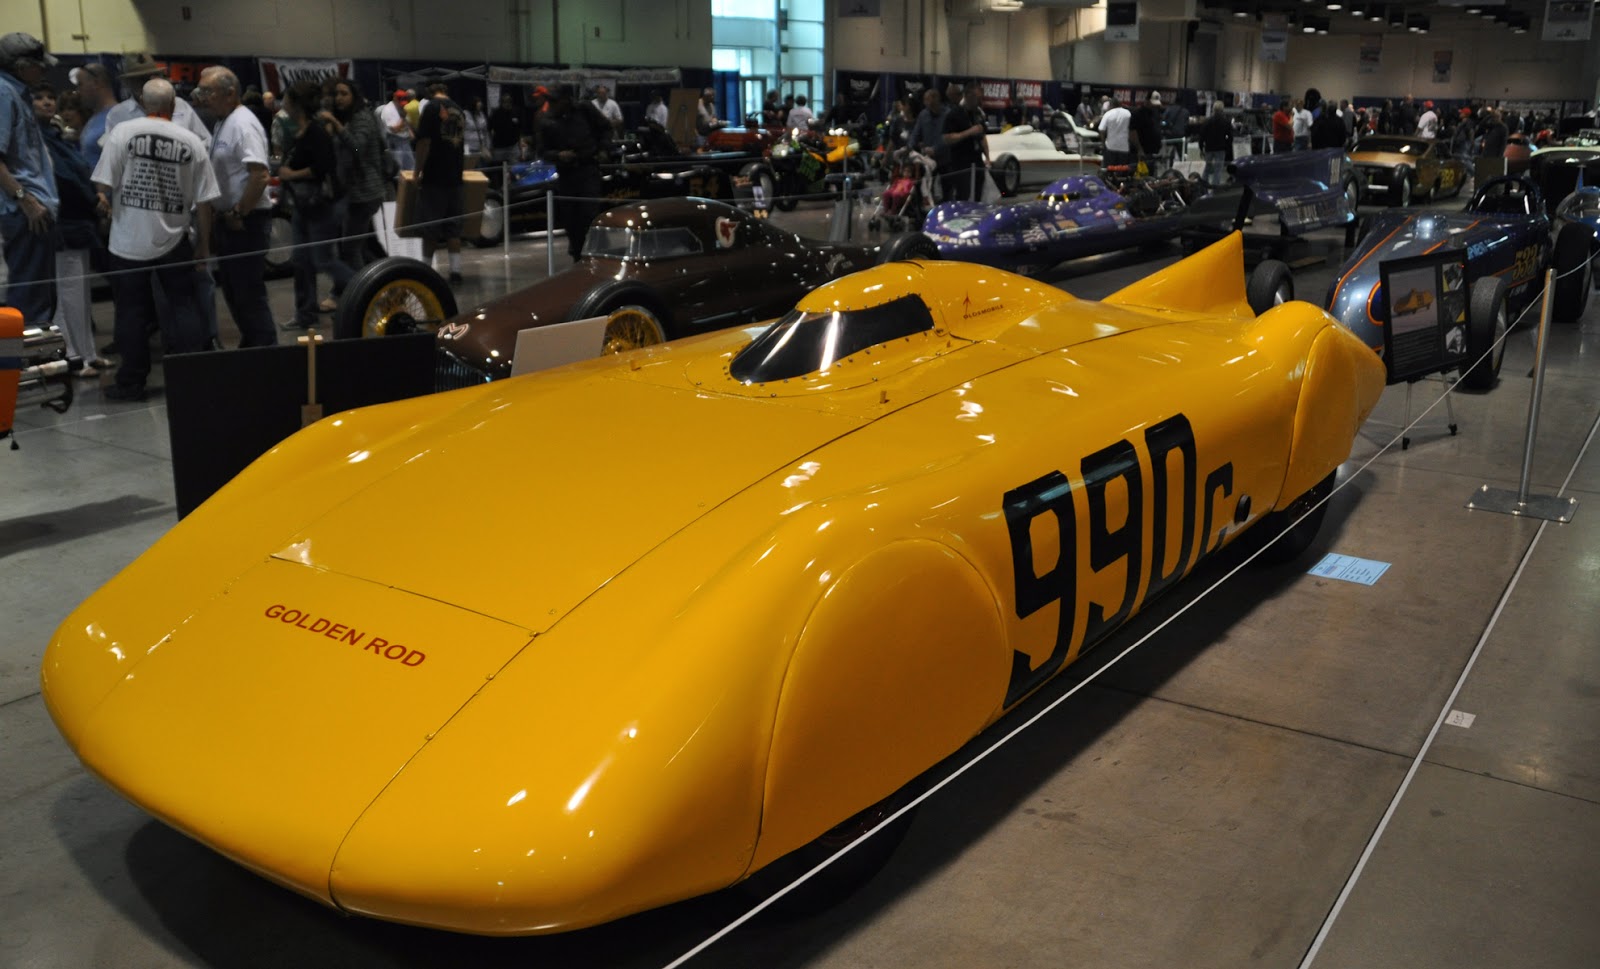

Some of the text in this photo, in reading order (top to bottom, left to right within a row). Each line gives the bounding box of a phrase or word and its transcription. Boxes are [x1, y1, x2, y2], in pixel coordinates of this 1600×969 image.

[127, 135, 152, 158] got
[963, 304, 1004, 319] OLDSMOBILE
[264, 604, 426, 667] GOLDEN ROD
